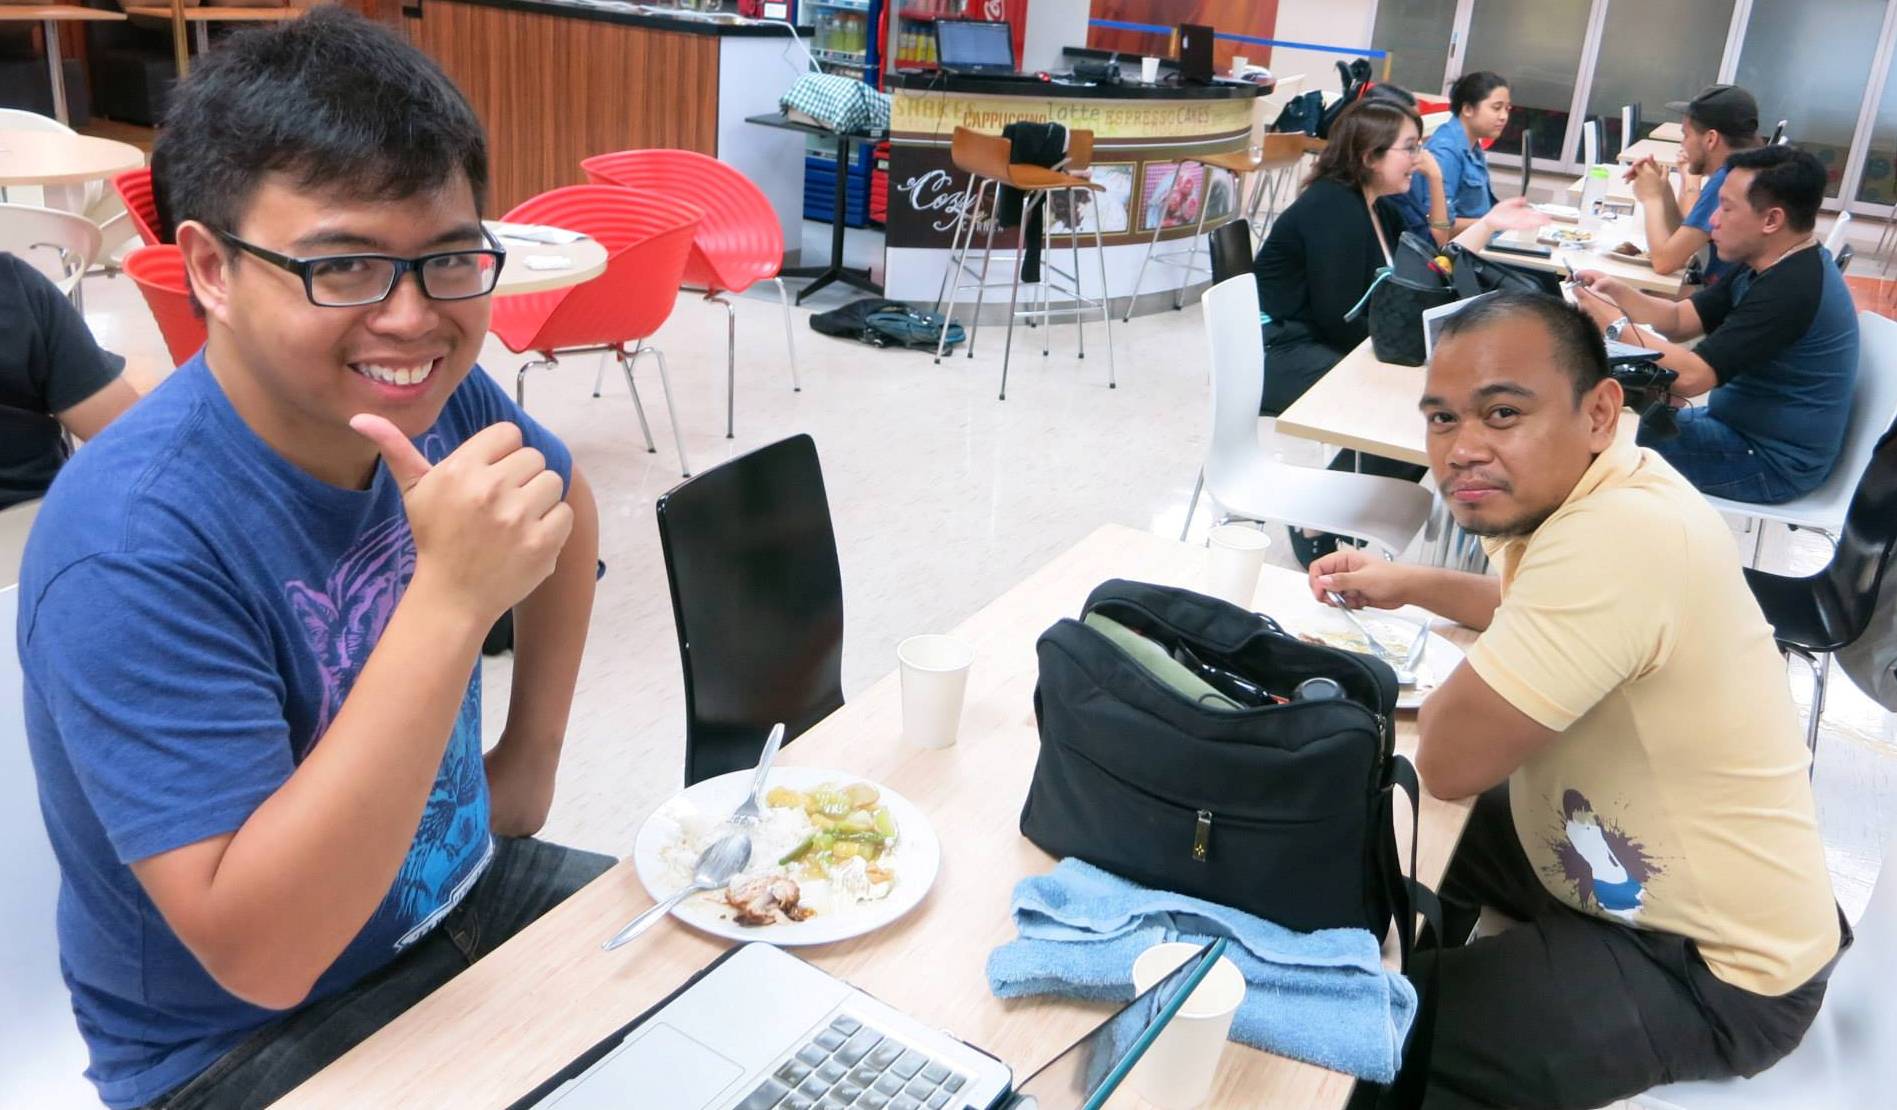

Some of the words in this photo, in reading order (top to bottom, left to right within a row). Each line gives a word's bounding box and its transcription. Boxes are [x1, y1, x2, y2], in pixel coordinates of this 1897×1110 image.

[1047, 102, 1100, 121] latte
[1105, 109, 1175, 126] ESPRESSO
[897, 169, 978, 231] Cozy
